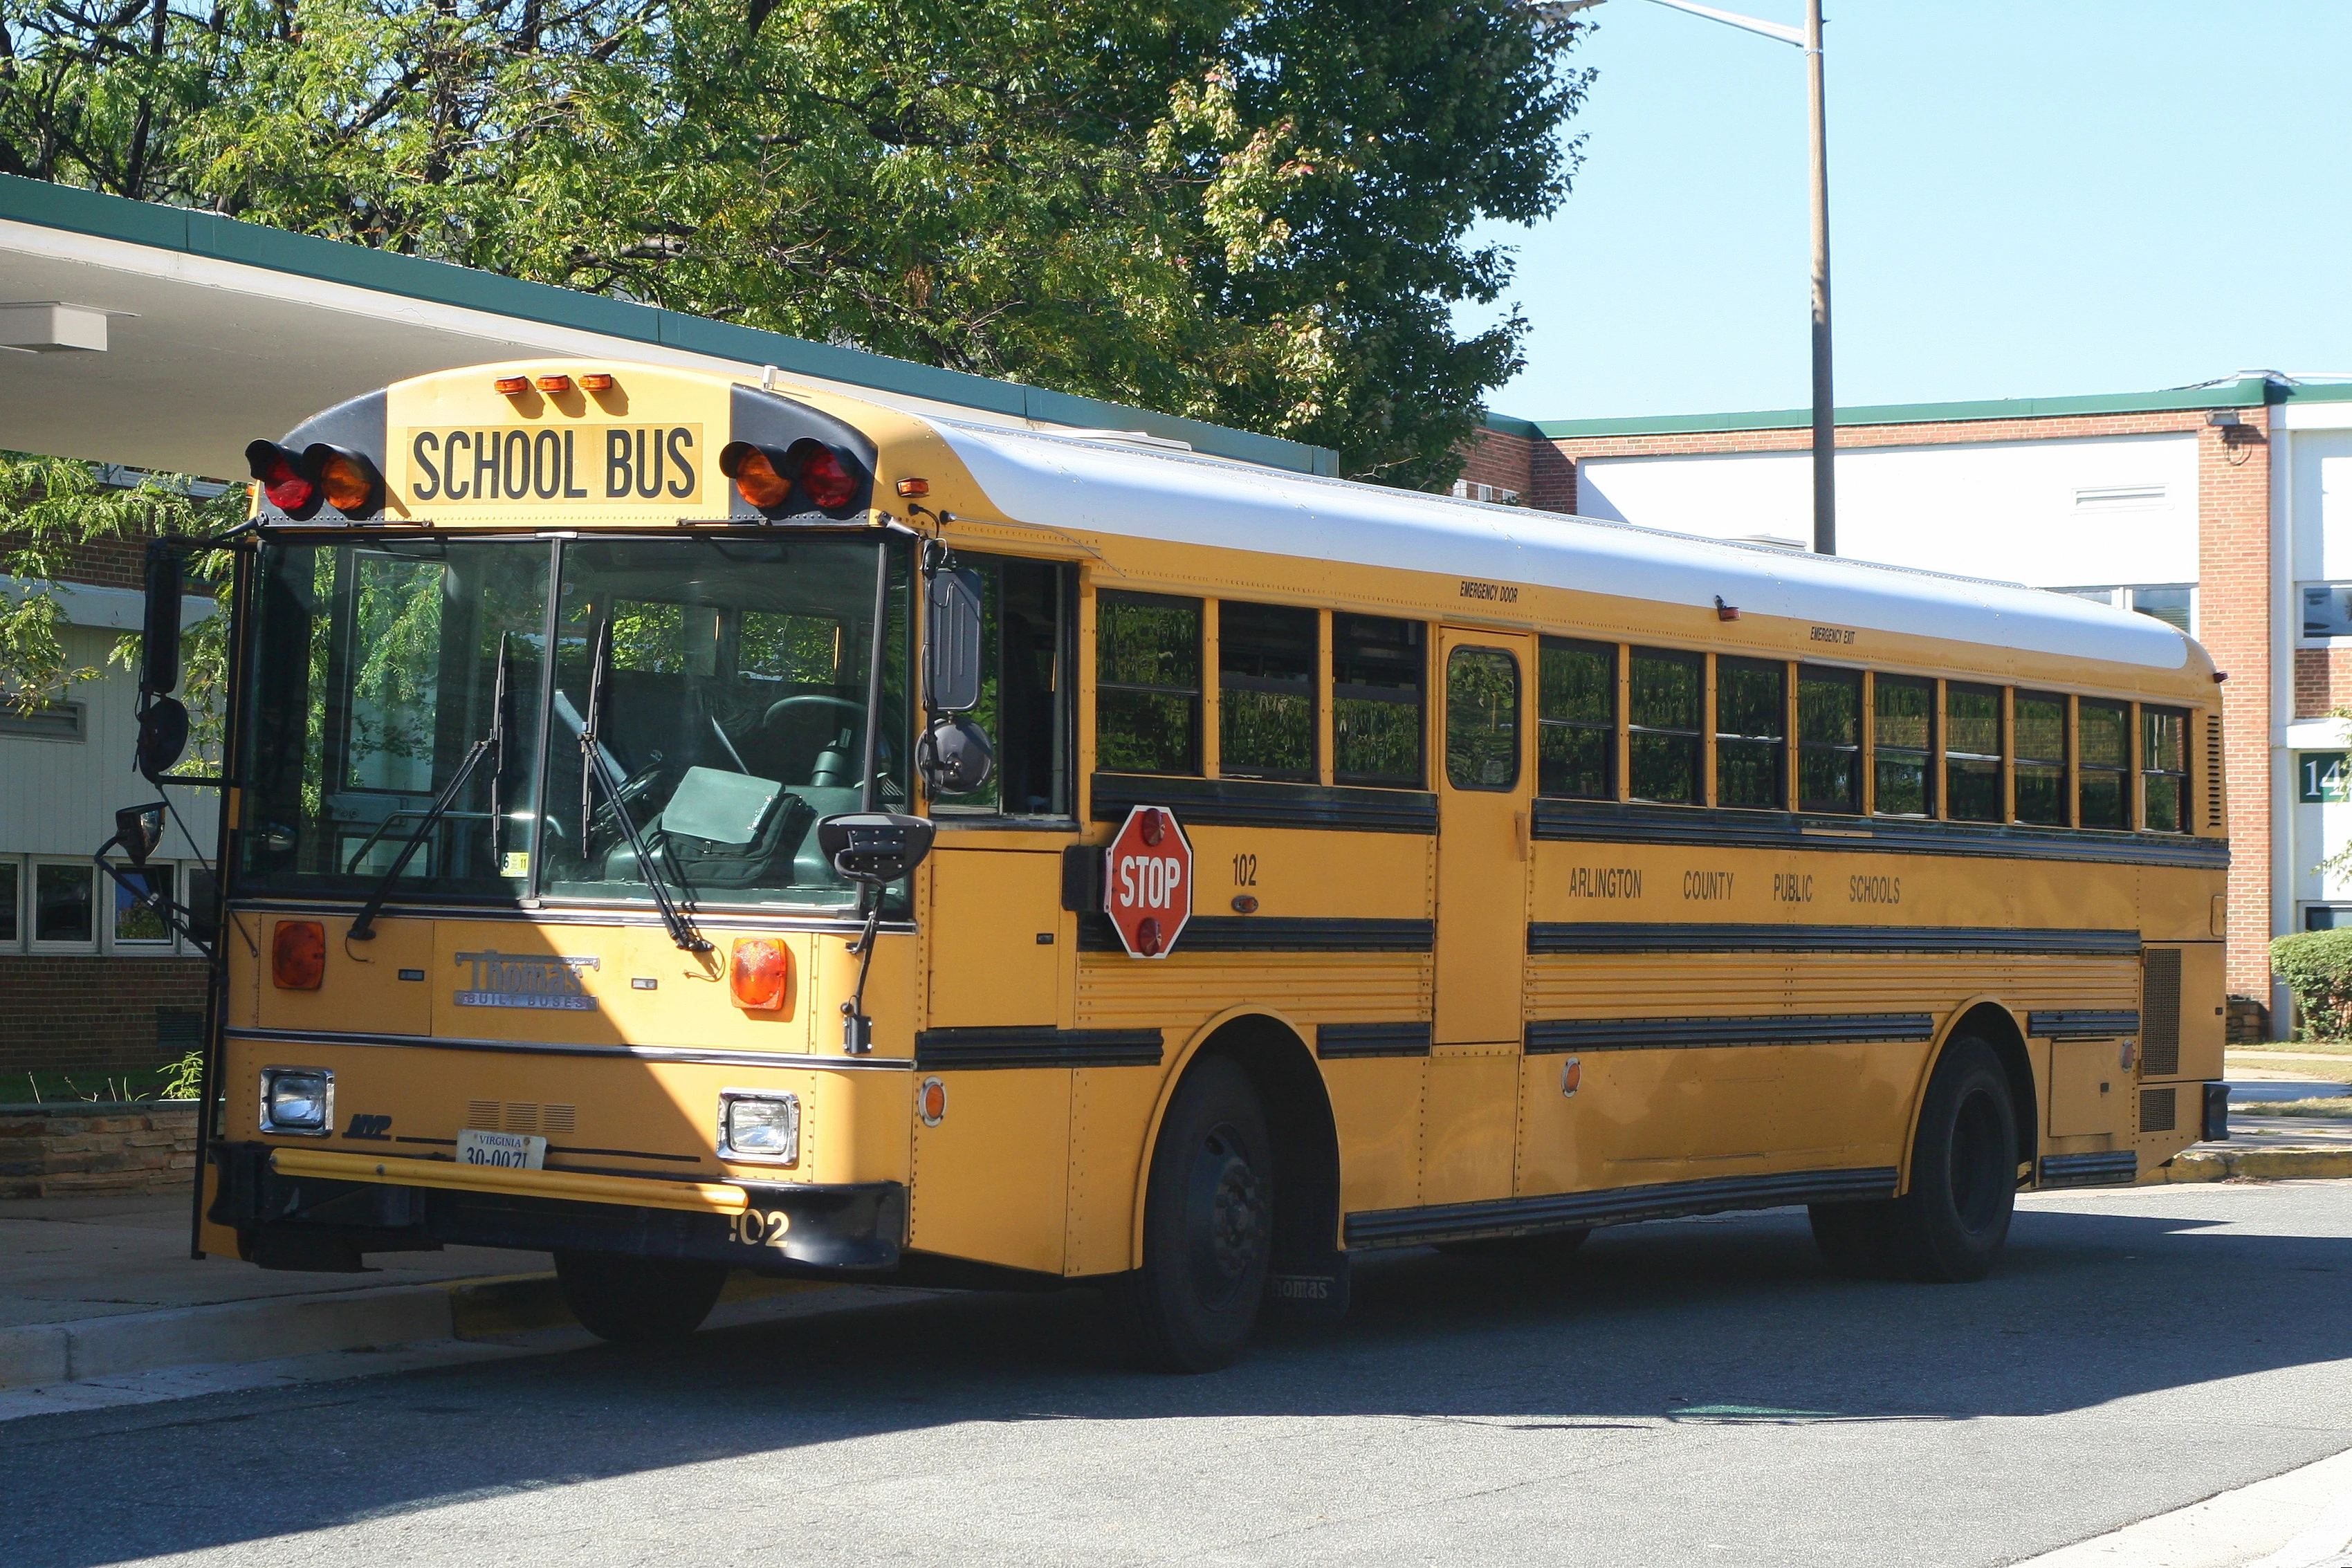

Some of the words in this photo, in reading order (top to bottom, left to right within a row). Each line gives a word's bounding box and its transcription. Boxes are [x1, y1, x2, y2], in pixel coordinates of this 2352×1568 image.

[413, 430, 587, 499] SCHOOL
[606, 427, 695, 498] BUS
[1460, 581, 1498, 600] EMERGENCY
[1500, 586, 1518, 603] DOOR
[1810, 627, 1842, 643] EMERGENCY
[1844, 630, 1855, 644] EXIT
[2306, 759, 2344, 795] 14
[1120, 856, 1181, 909] STOP
[1233, 854, 1257, 887] 102
[1569, 867, 1642, 898] ARLINGTON
[1684, 870, 1734, 900] COUNTY
[1774, 874, 1813, 902] PUBLIC
[1849, 875, 1900, 904] SCHOOLS
[454, 950, 600, 995] Thomas
[467, 992, 517, 1005] BUILT
[528, 996, 585, 1008] BUSES
[479, 1135, 522, 1147] VIRGINIA
